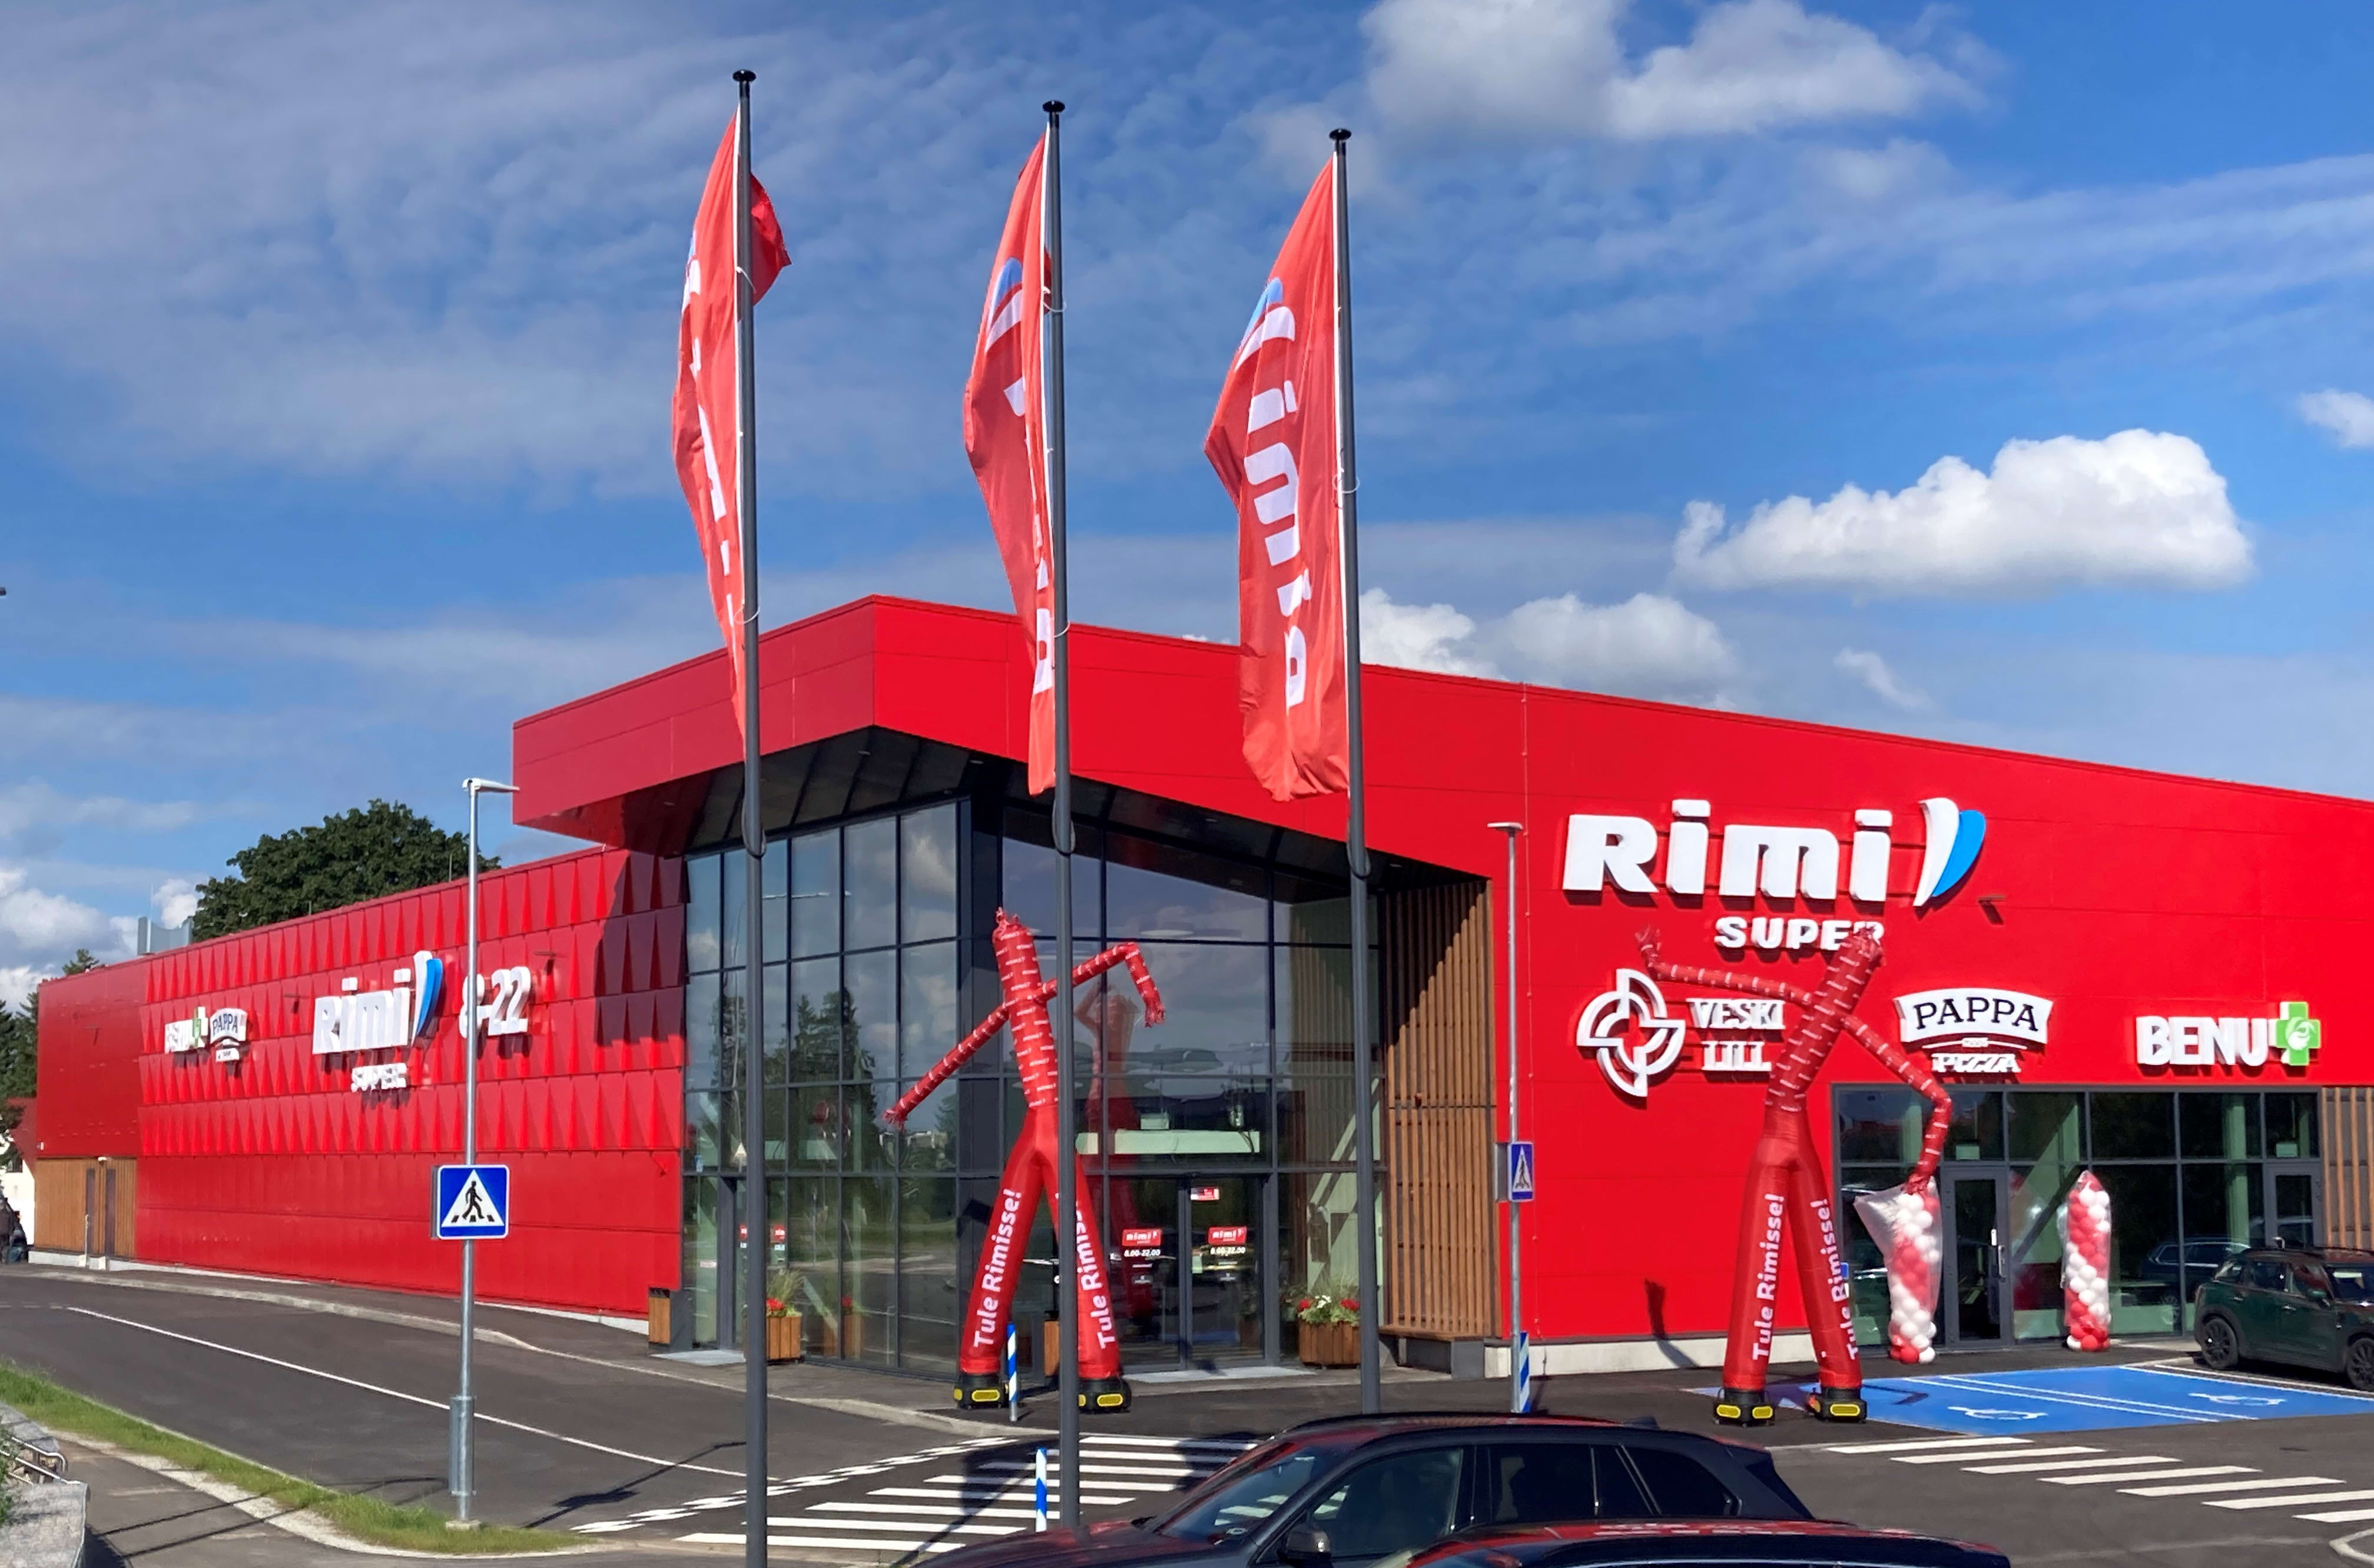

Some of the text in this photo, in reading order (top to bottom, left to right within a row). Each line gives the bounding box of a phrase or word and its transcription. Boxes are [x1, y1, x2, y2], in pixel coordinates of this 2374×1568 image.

[1563, 800, 1893, 903] Rimi
[313, 969, 411, 1054] Rimi
[1686, 998, 1786, 1030] VESKI
[1913, 996, 2038, 1032] PAPPA
[2136, 1016, 2269, 1066] BENU
[973, 1188, 1022, 1348] Tule Rimisse!
[1752, 1194, 1785, 1361] Tule Rimisse!
[1810, 1198, 1849, 1303] Rimisse!
[1090, 1295, 1116, 1350] Tule
